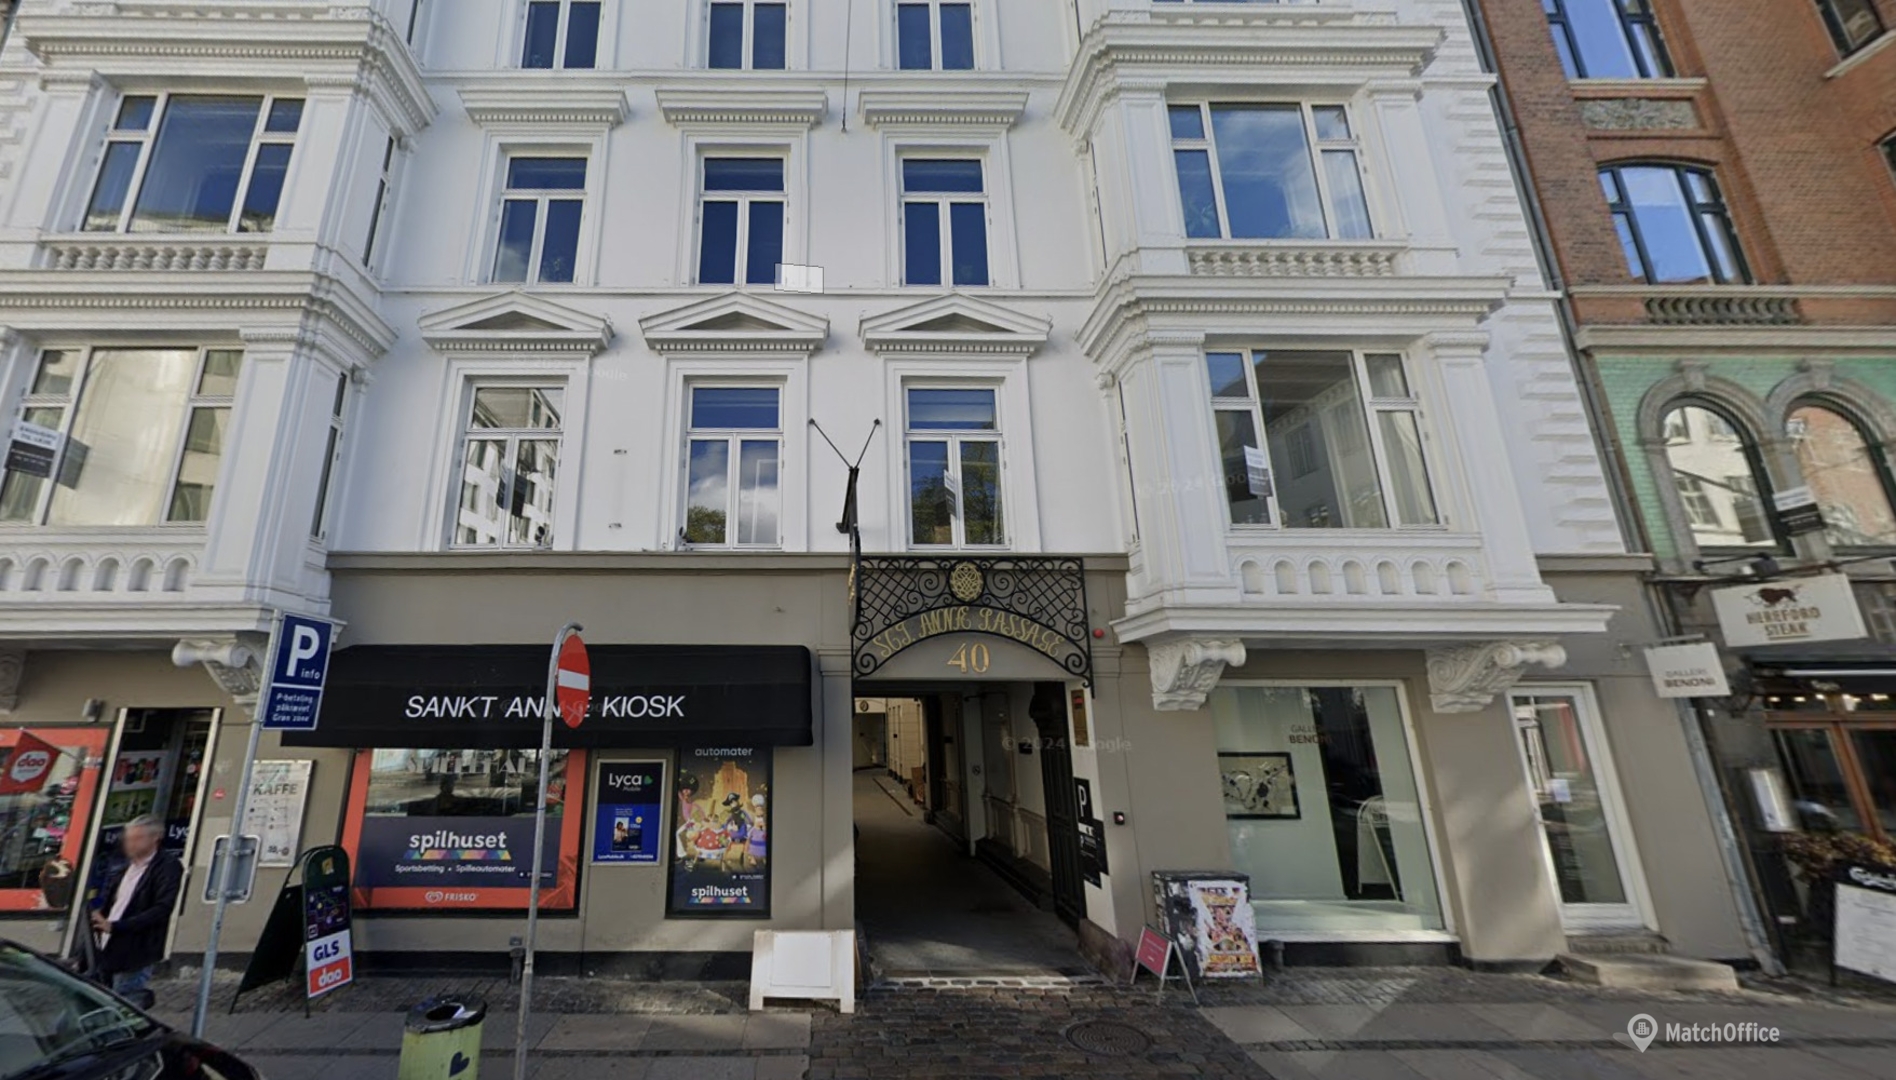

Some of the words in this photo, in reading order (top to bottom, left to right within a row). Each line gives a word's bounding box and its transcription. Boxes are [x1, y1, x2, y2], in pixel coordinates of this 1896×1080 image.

[1746, 606, 1821, 625] HEREFORD
[978, 607, 1065, 657] PASSAGE
[1764, 622, 1809, 636] STEAK
[286, 624, 320, 677] P
[947, 642, 990, 673] 40
[302, 668, 320, 679] info
[1663, 677, 1716, 688] BENONI
[405, 696, 498, 718] SANKT
[505, 696, 592, 718] ANN
[602, 696, 686, 717] KIOSK
[695, 746, 753, 756] automater
[18, 754, 46, 767] dao
[609, 773, 643, 788] Lyca
[253, 783, 299, 795] KAFFE
[409, 830, 508, 854] spilhuset
[395, 864, 445, 874] Sportsbetting
[455, 863, 516, 873] Spilleautomater
[444, 891, 477, 902] FRISKO
[691, 885, 748, 899] spilhuset
[313, 940, 340, 961] GLS
[318, 967, 343, 988] dao
